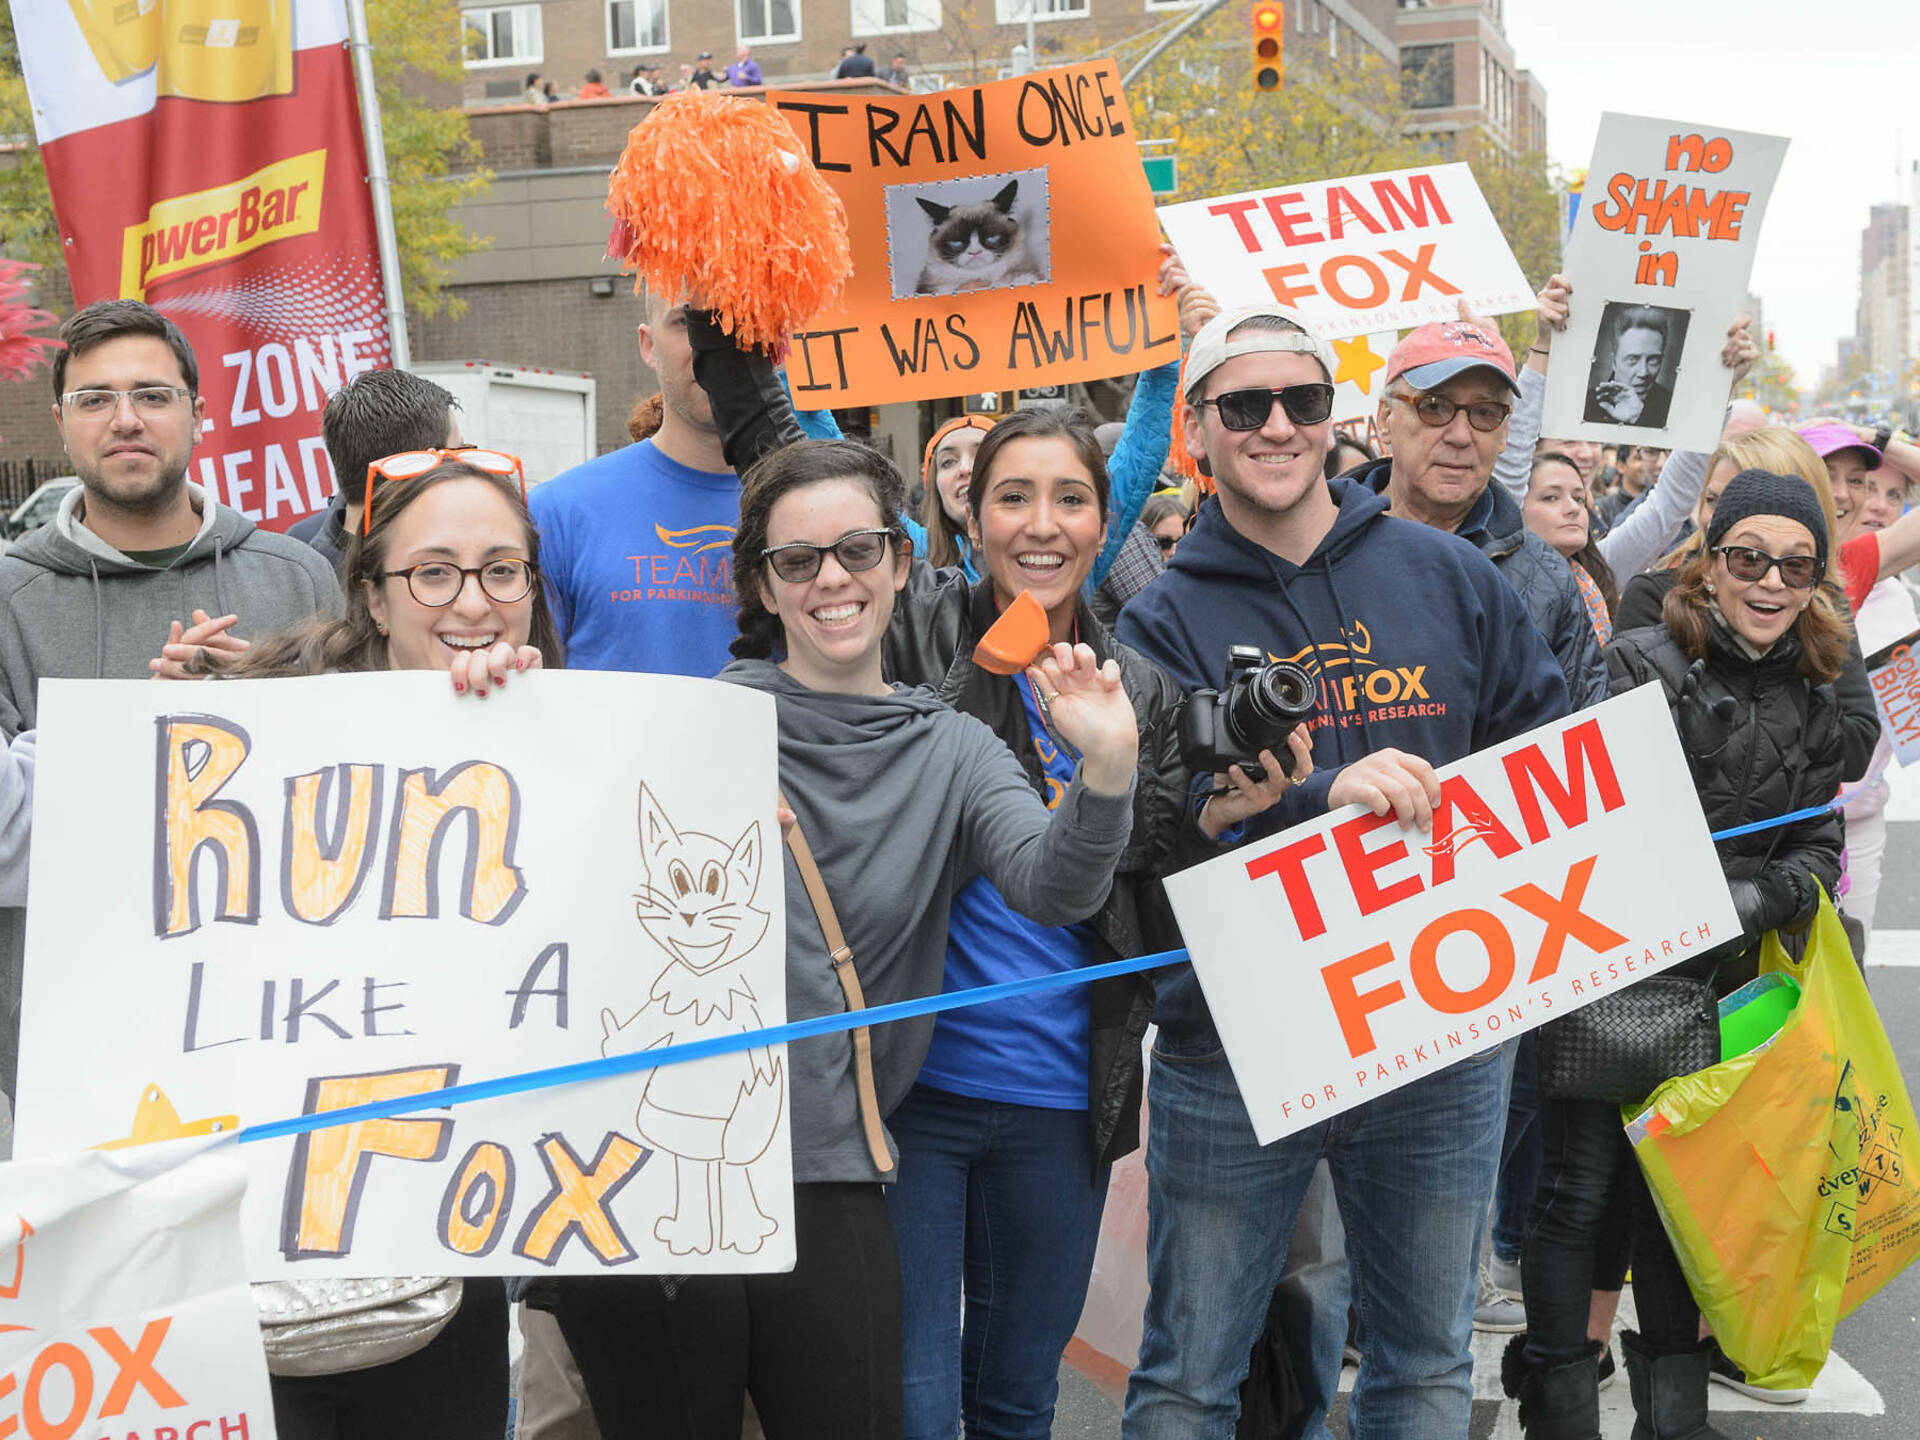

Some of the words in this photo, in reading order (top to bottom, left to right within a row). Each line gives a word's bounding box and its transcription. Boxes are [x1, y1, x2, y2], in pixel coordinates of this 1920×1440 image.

[777, 101, 852, 173] I
[865, 88, 987, 167] RAN
[1016, 70, 1126, 147] ONCE
[1207, 174, 1454, 254] TEAM
[1592, 172, 1752, 241] SHAME
[1261, 243, 1464, 310] FOX
[1634, 240, 1679, 288] in
[793, 326, 859, 391] IT
[880, 313, 981, 377] WAS
[1006, 284, 1176, 369] AWFUL
[222, 329, 375, 427] ZONE
[610, 589, 642, 604] FOR
[626, 555, 729, 589] TEAM
[1342, 665, 1431, 711] FOX
[1368, 703, 1447, 723] RESEARCH
[1244, 718, 1626, 942] TEAM
[1320, 854, 1631, 1060] FOX
[182, 961, 416, 1053] LIKE
[505, 942, 570, 1030] A
[1281, 1084, 1338, 1119] FOR
[1356, 991, 1554, 1088] PARKINSON'S
[1572, 922, 1712, 996] RESEARCH
